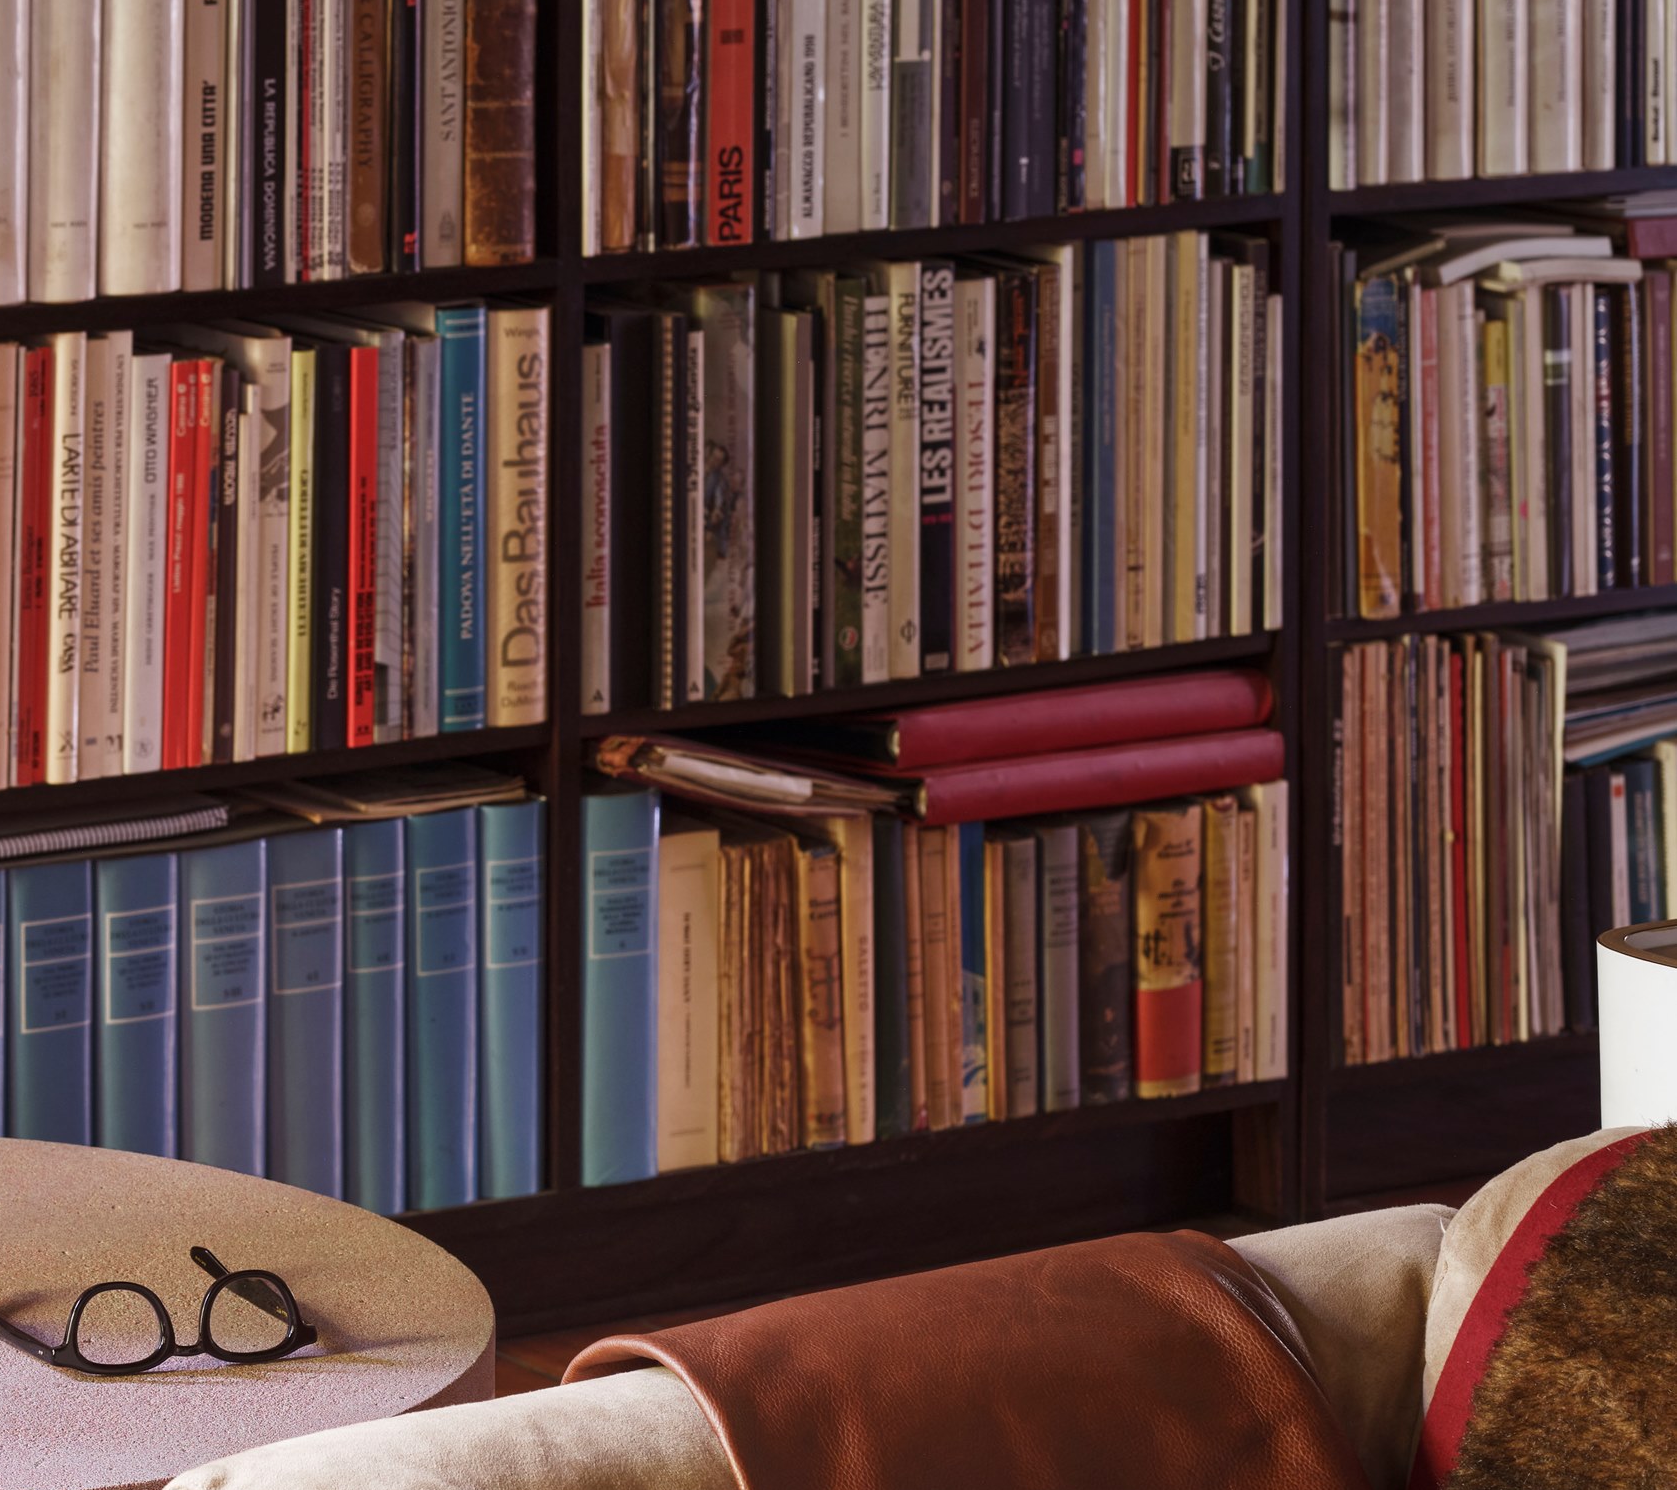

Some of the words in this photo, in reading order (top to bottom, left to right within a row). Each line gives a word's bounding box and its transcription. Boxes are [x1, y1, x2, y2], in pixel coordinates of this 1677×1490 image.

[357, 11, 374, 167] CALLIGRAPHY
[718, 147, 742, 241] PARIS
[864, 308, 888, 433] HENRI
[921, 269, 952, 439] REALISMES
[461, 393, 473, 458] DANTE
[461, 463, 473, 480] DI
[506, 353, 544, 563] Bauhaus
[921, 445, 951, 503] LES
[460, 487, 473, 567] NELL'ETÀ
[863, 449, 887, 609] MATISSE
[460, 575, 472, 641] PADOVA
[502, 573, 542, 668] Das
